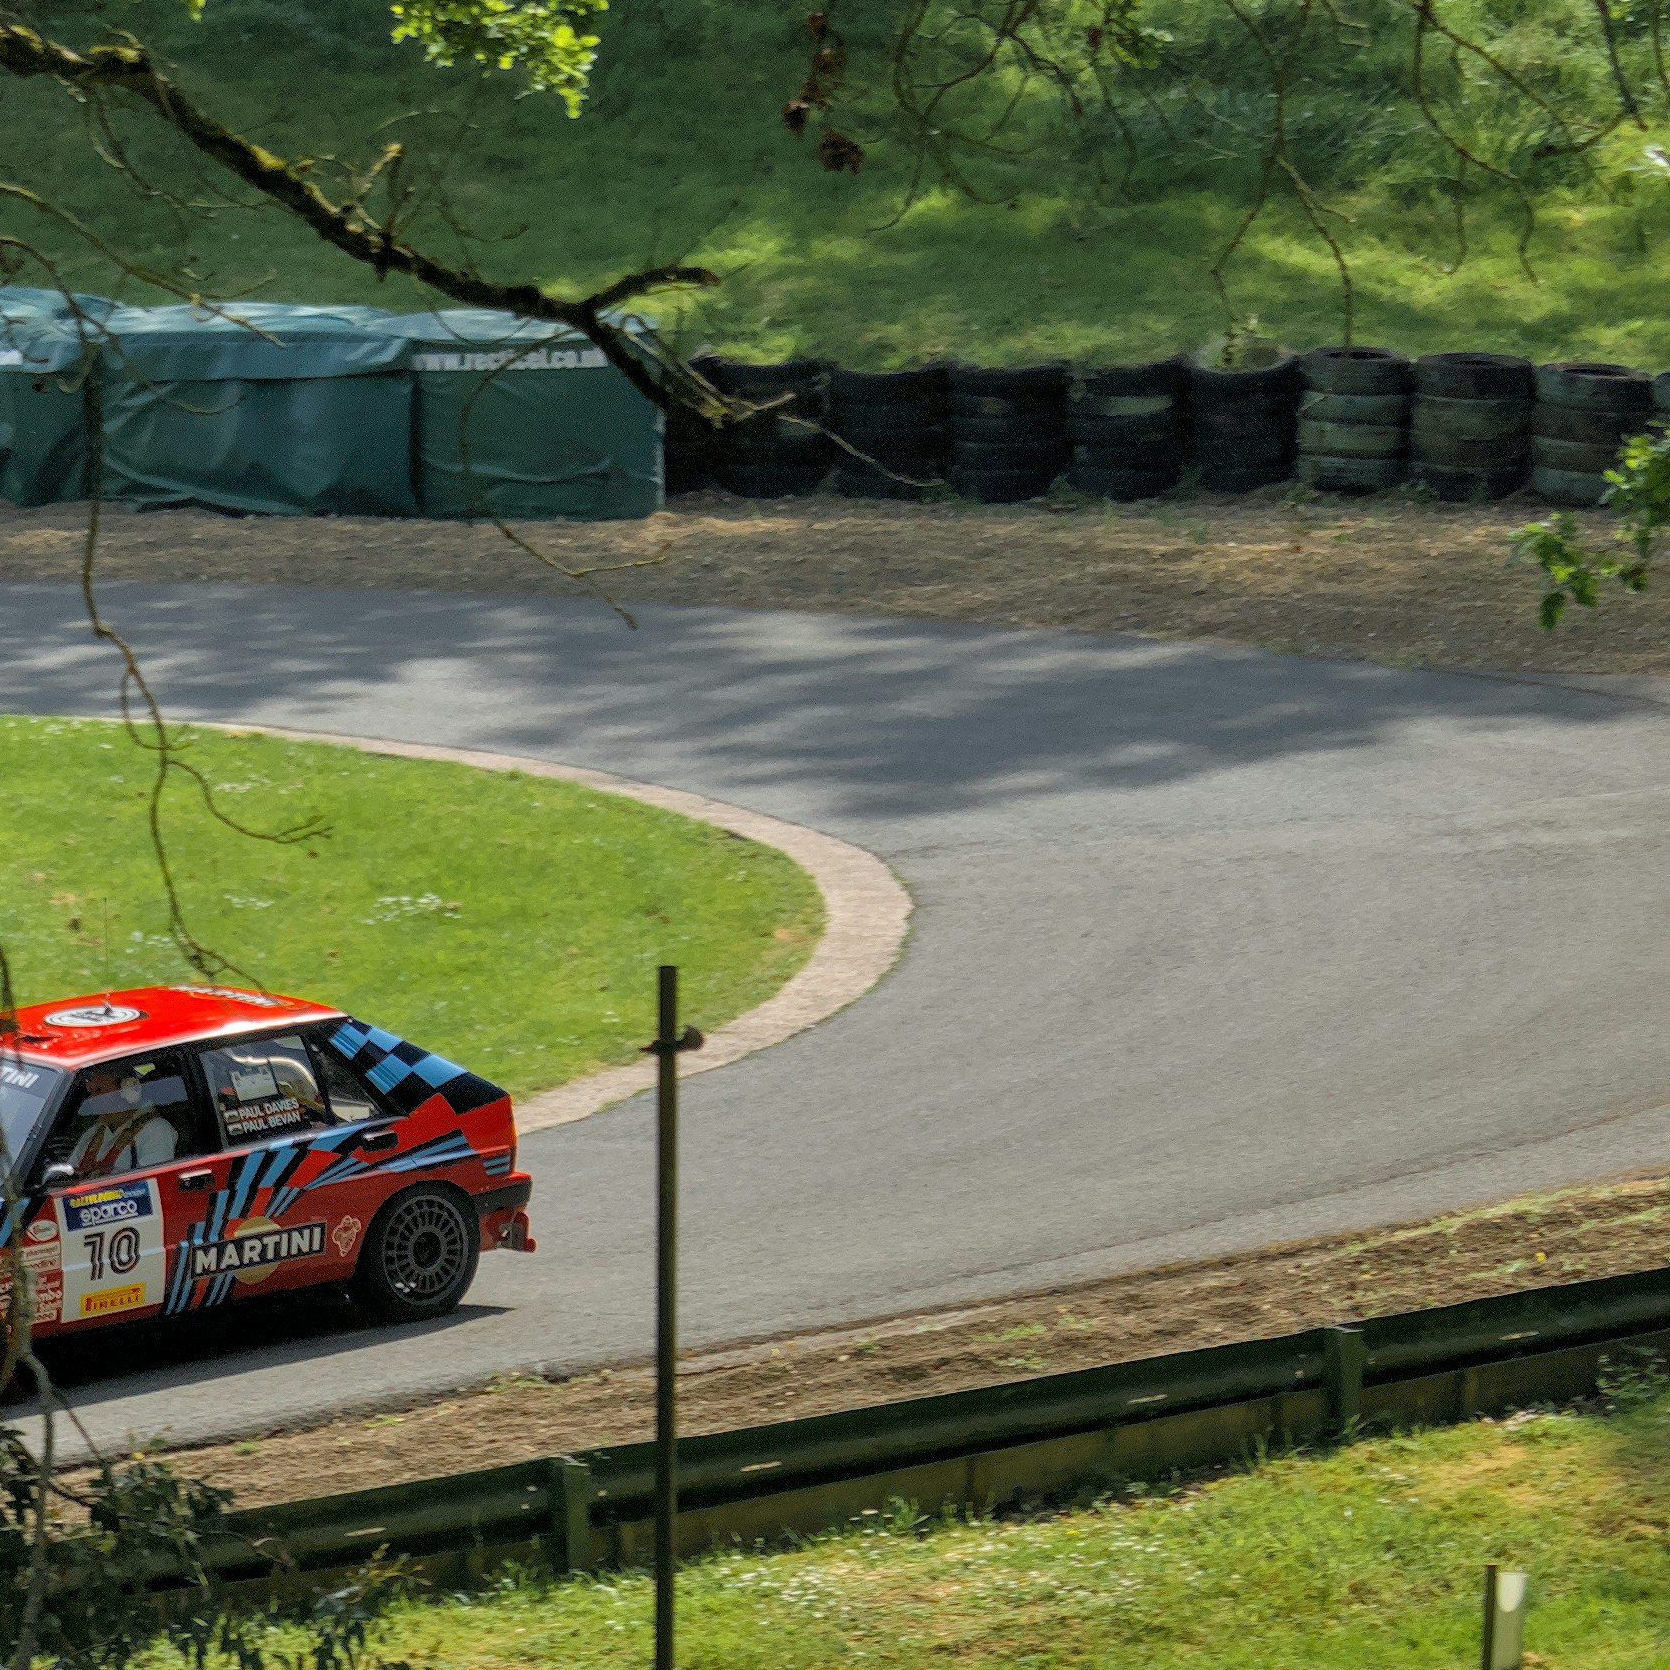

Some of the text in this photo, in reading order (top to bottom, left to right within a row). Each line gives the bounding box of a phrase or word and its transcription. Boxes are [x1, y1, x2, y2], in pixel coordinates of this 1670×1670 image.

[239, 1097, 300, 1121] PAUL DAVIES
[243, 1110, 302, 1134] PAUL BEVAN
[194, 1226, 322, 1275] MARTINI
[85, 1287, 141, 1312] PIRELLI
